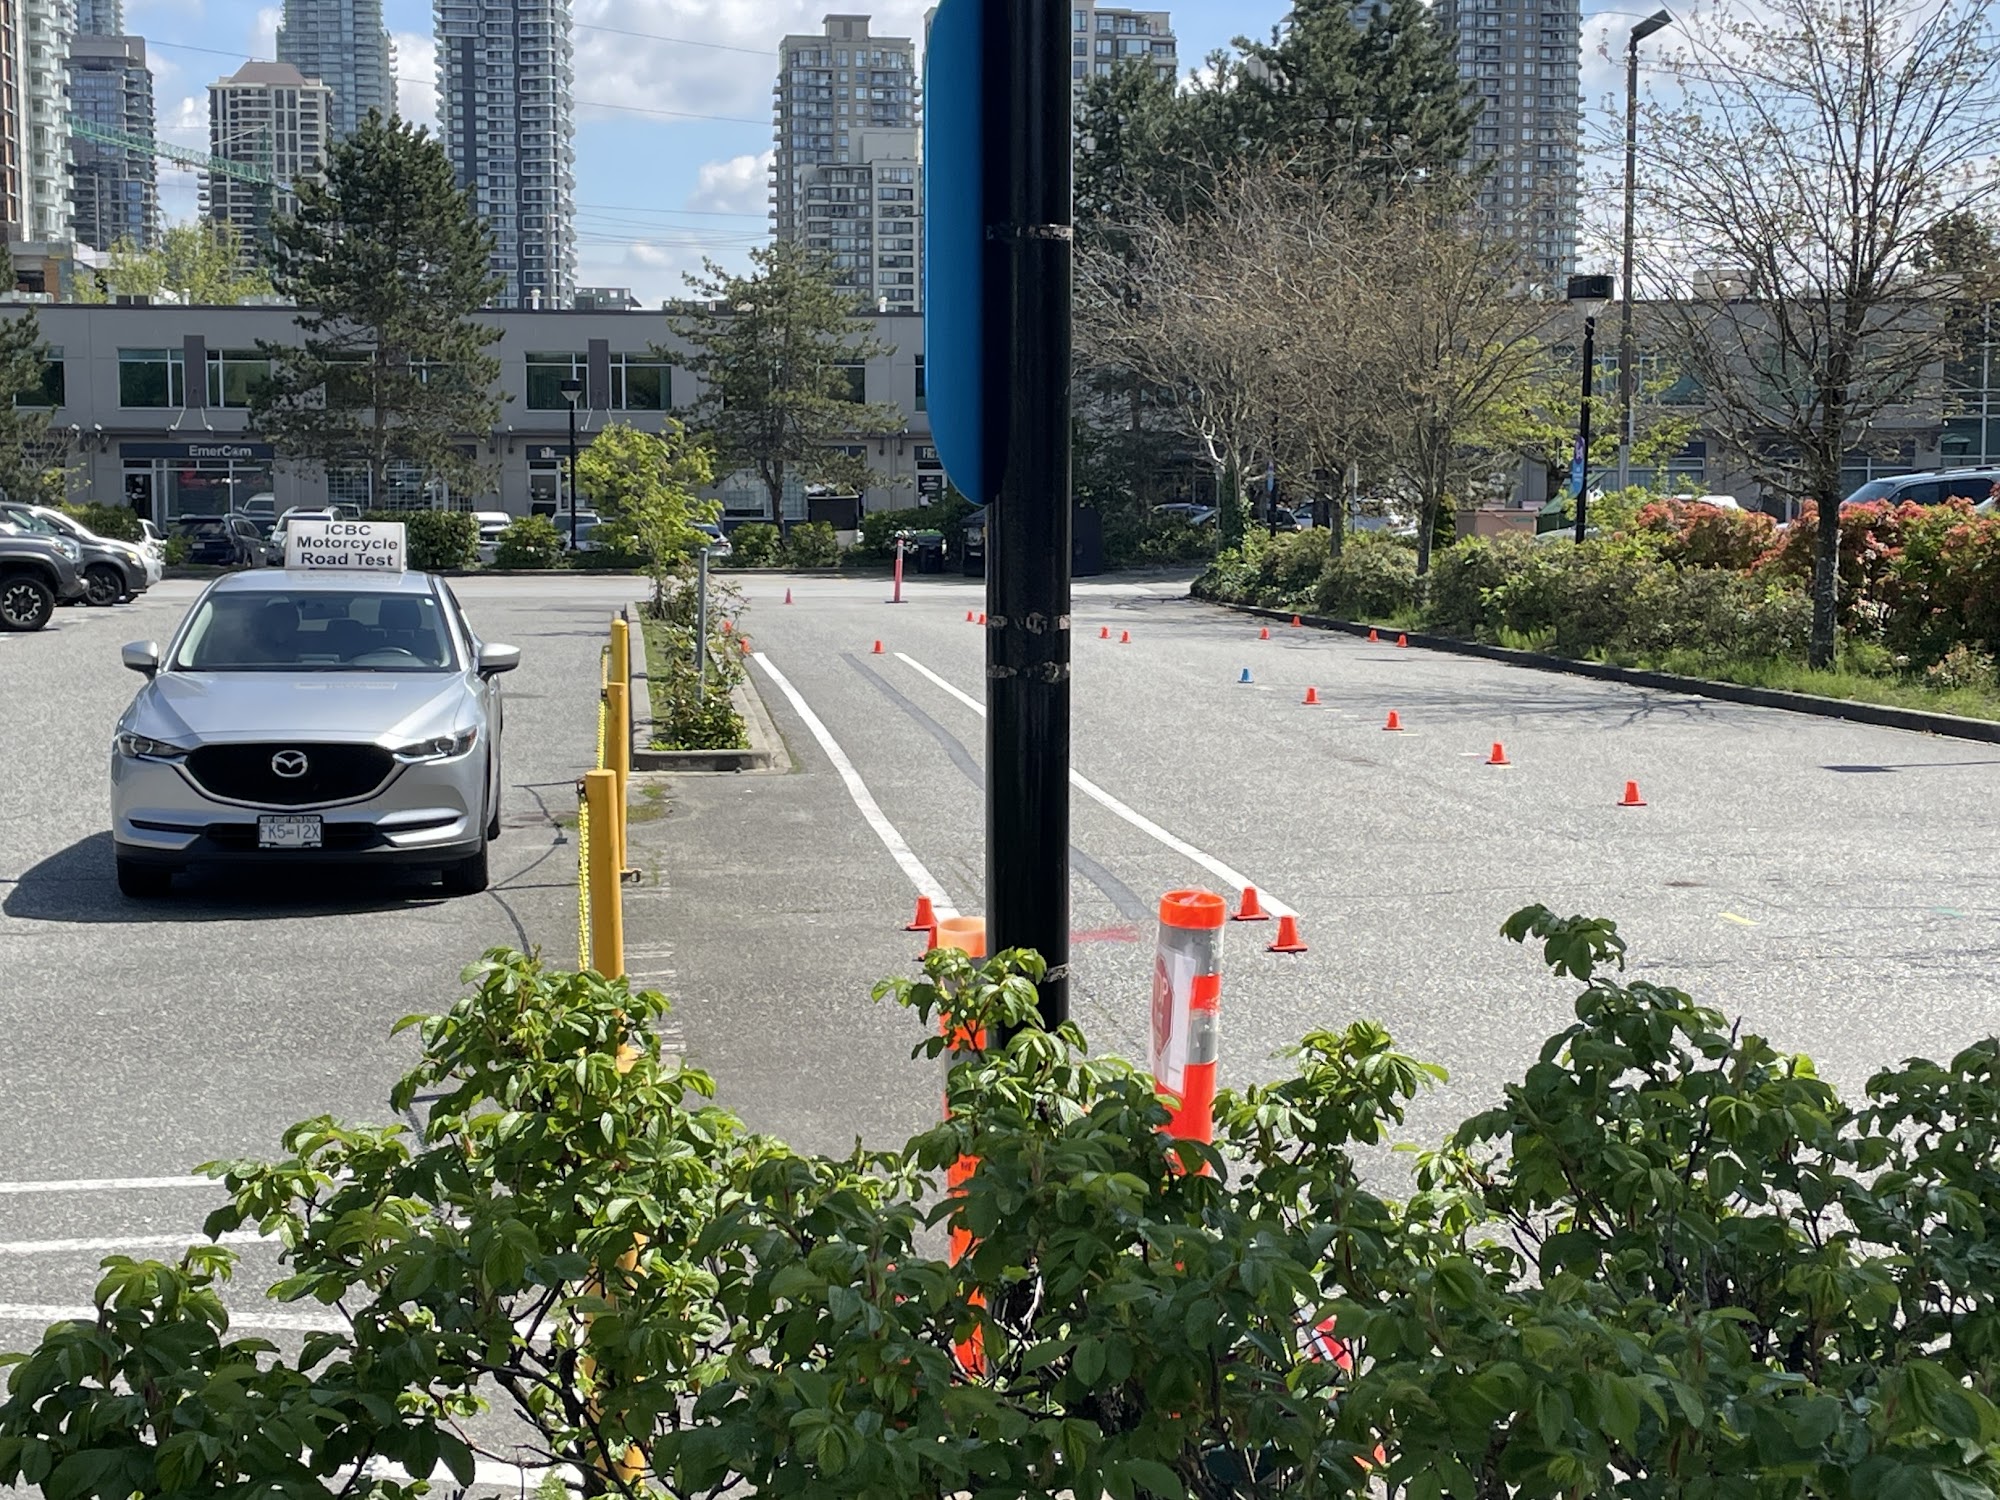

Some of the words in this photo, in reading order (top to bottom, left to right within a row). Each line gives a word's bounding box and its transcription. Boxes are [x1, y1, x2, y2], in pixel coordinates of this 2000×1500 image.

[325, 524, 371, 536] ICBC
[297, 536, 398, 552] Motorcycle
[301, 552, 348, 565] Road
[354, 553, 393, 566] Test
